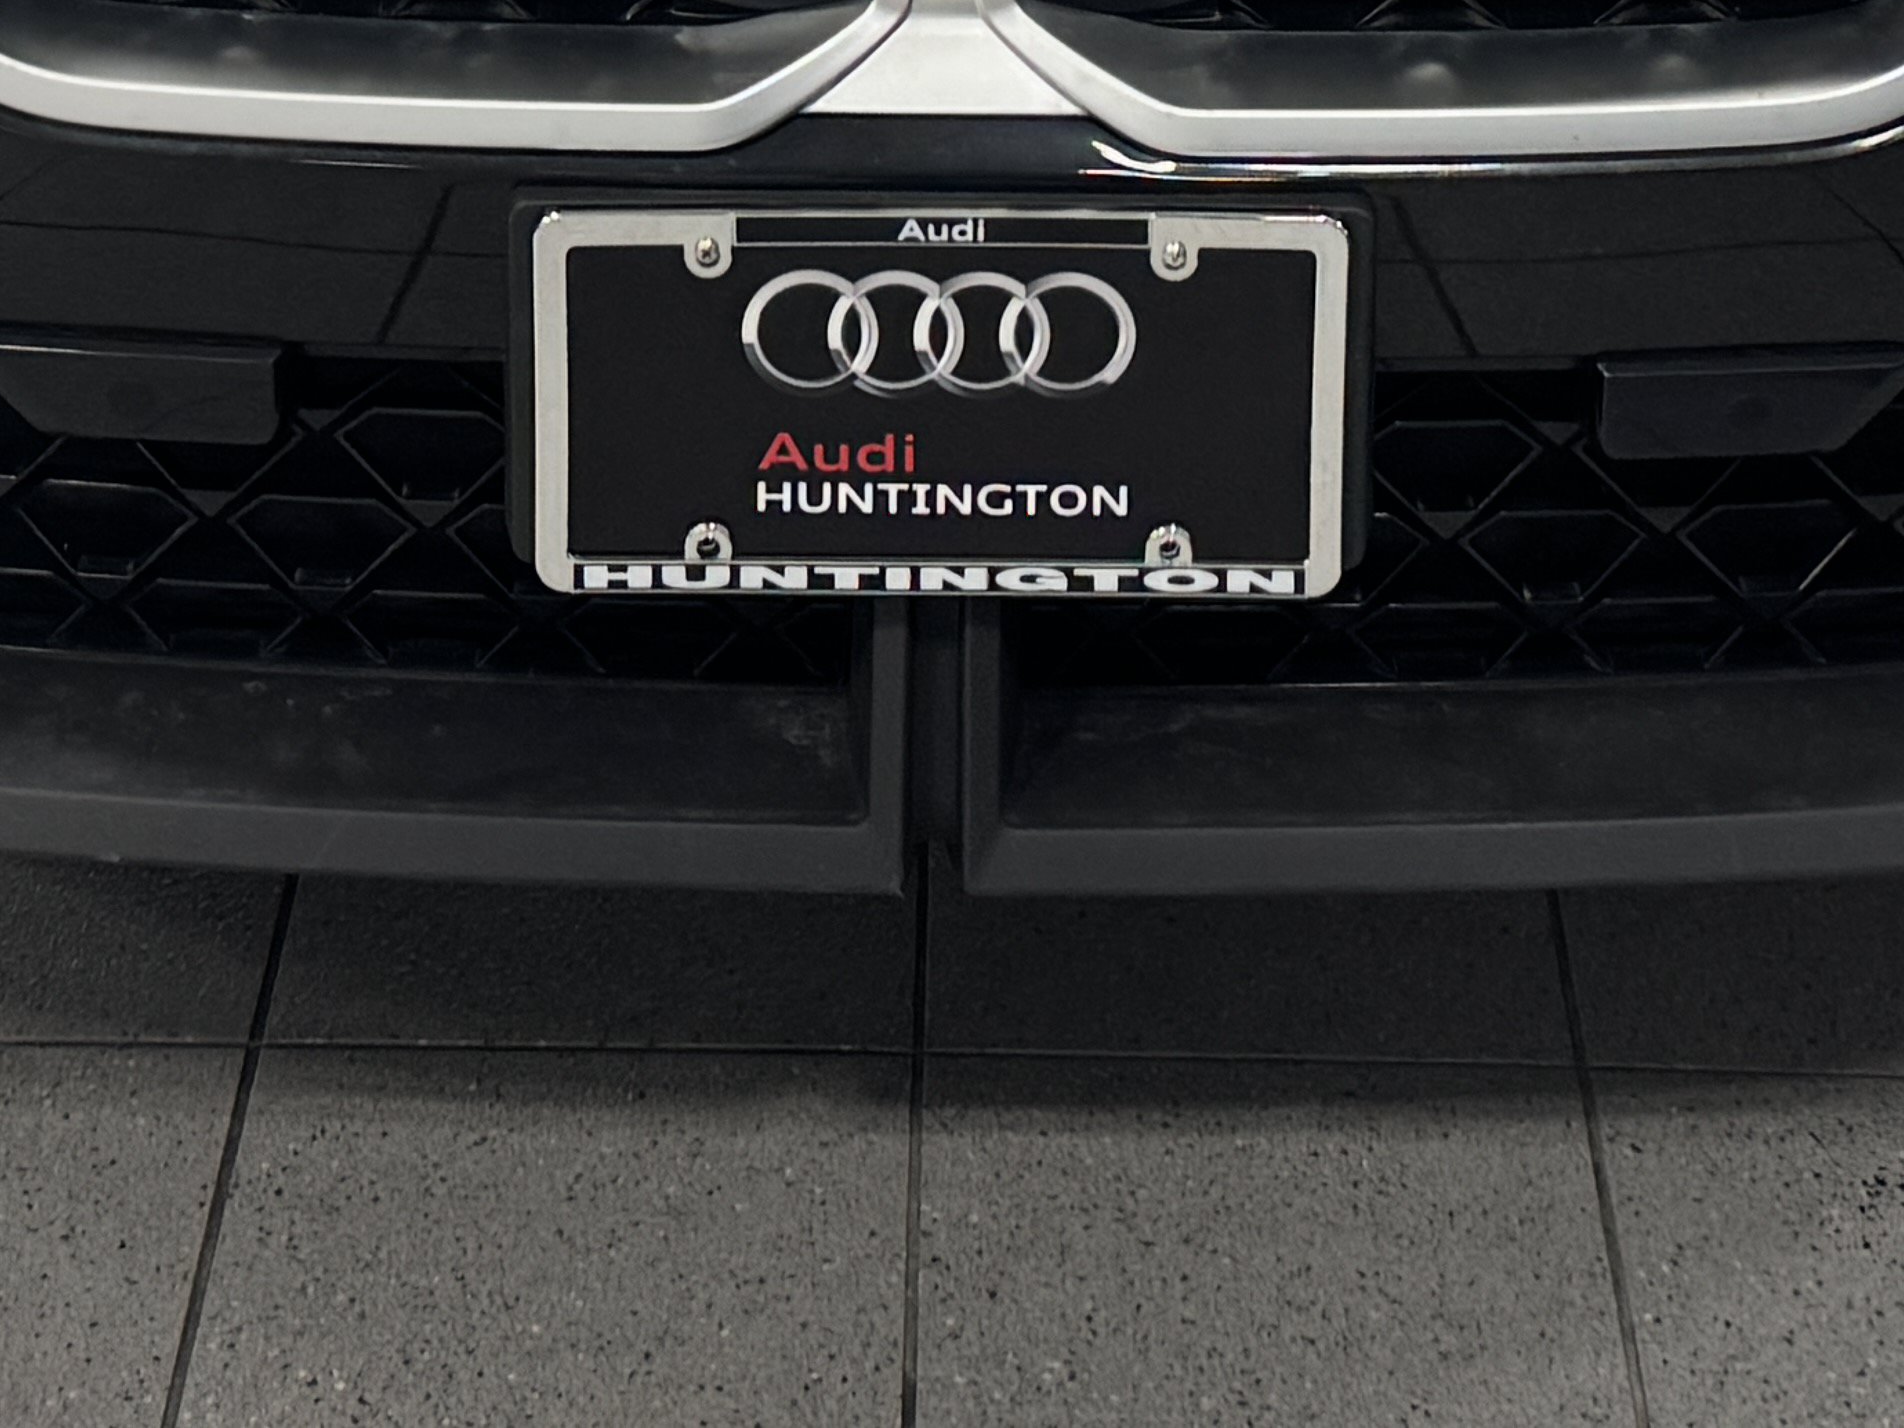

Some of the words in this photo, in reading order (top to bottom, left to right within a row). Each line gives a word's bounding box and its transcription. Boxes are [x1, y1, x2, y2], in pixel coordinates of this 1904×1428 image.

[898, 217, 985, 243] Audi
[758, 432, 917, 473] Audi
[756, 482, 1130, 517] HUNTINGTON
[582, 564, 1297, 594] HUNTINGTON
